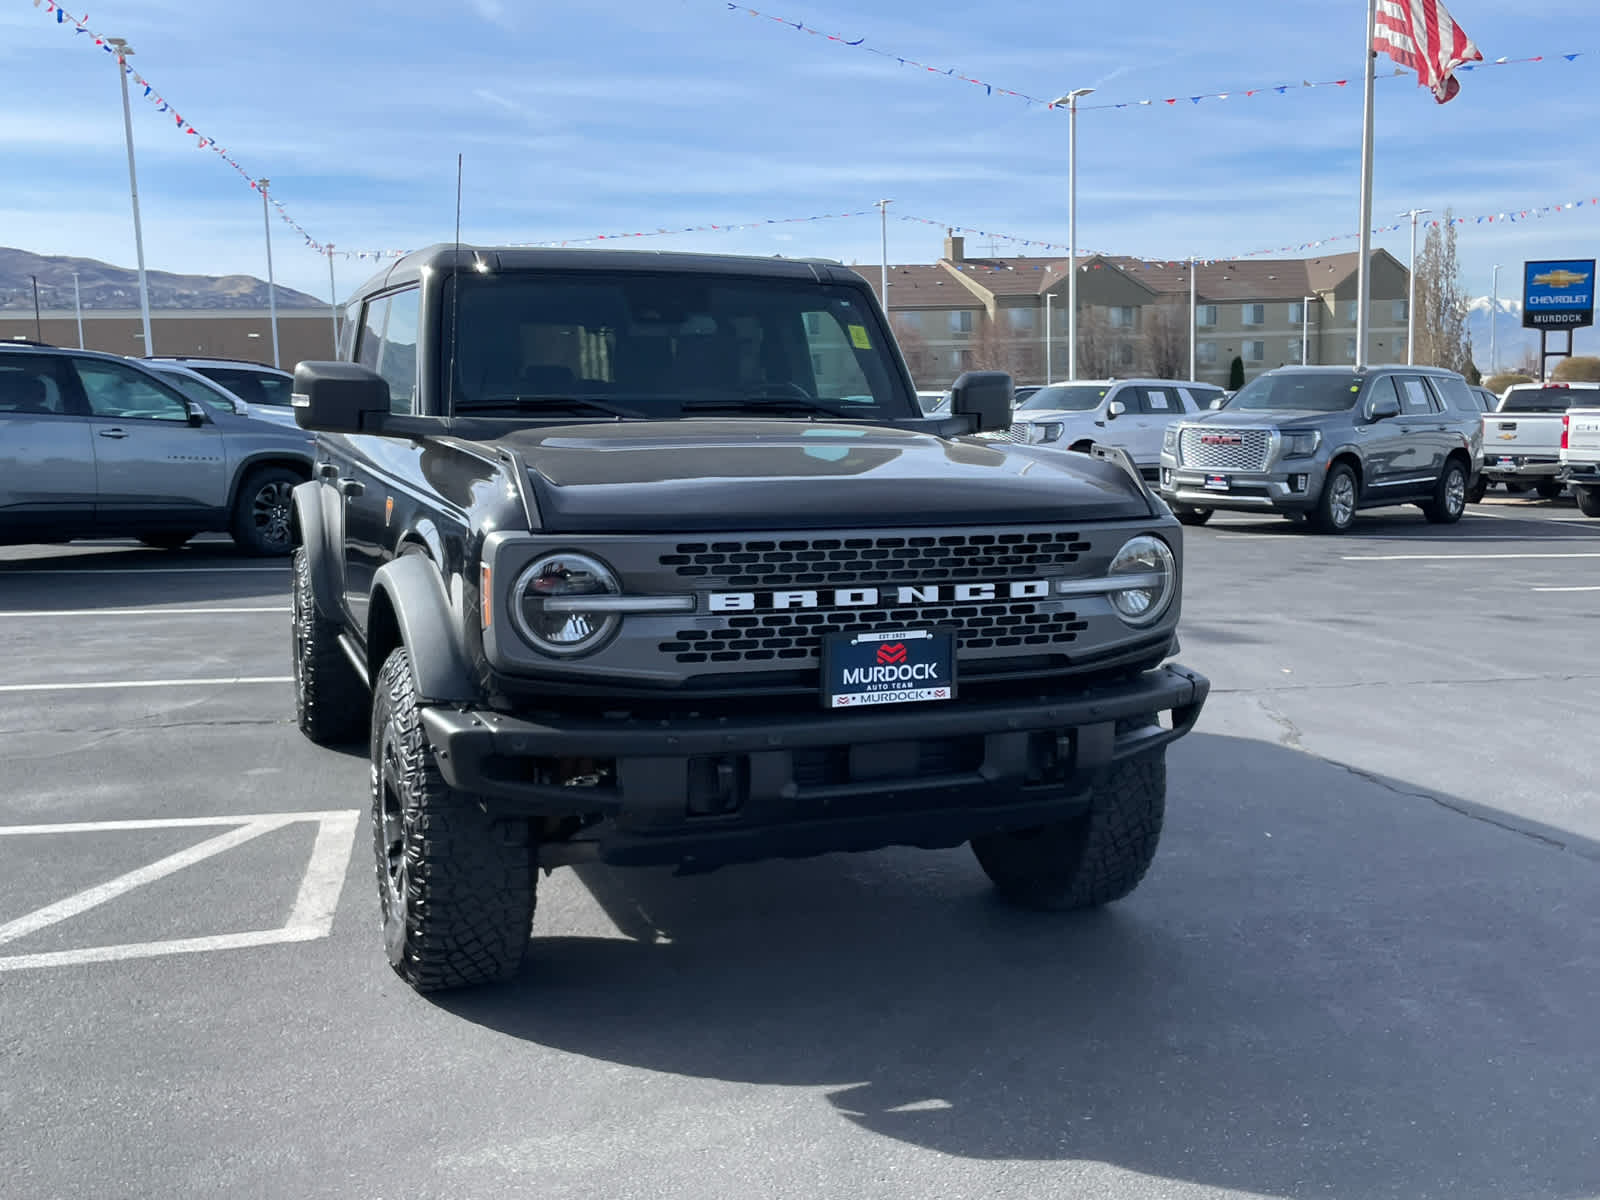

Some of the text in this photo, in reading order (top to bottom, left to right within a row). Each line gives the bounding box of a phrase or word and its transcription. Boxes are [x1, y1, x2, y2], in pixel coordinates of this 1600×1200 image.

[1529, 295, 1588, 305] CHEVROLET
[1534, 314, 1582, 323] MURDOCK
[708, 580, 1049, 611] BRONCO
[843, 662, 938, 685] MURDOCK
[866, 683, 889, 691] AUTO
[860, 690, 925, 703] MURDOCK
